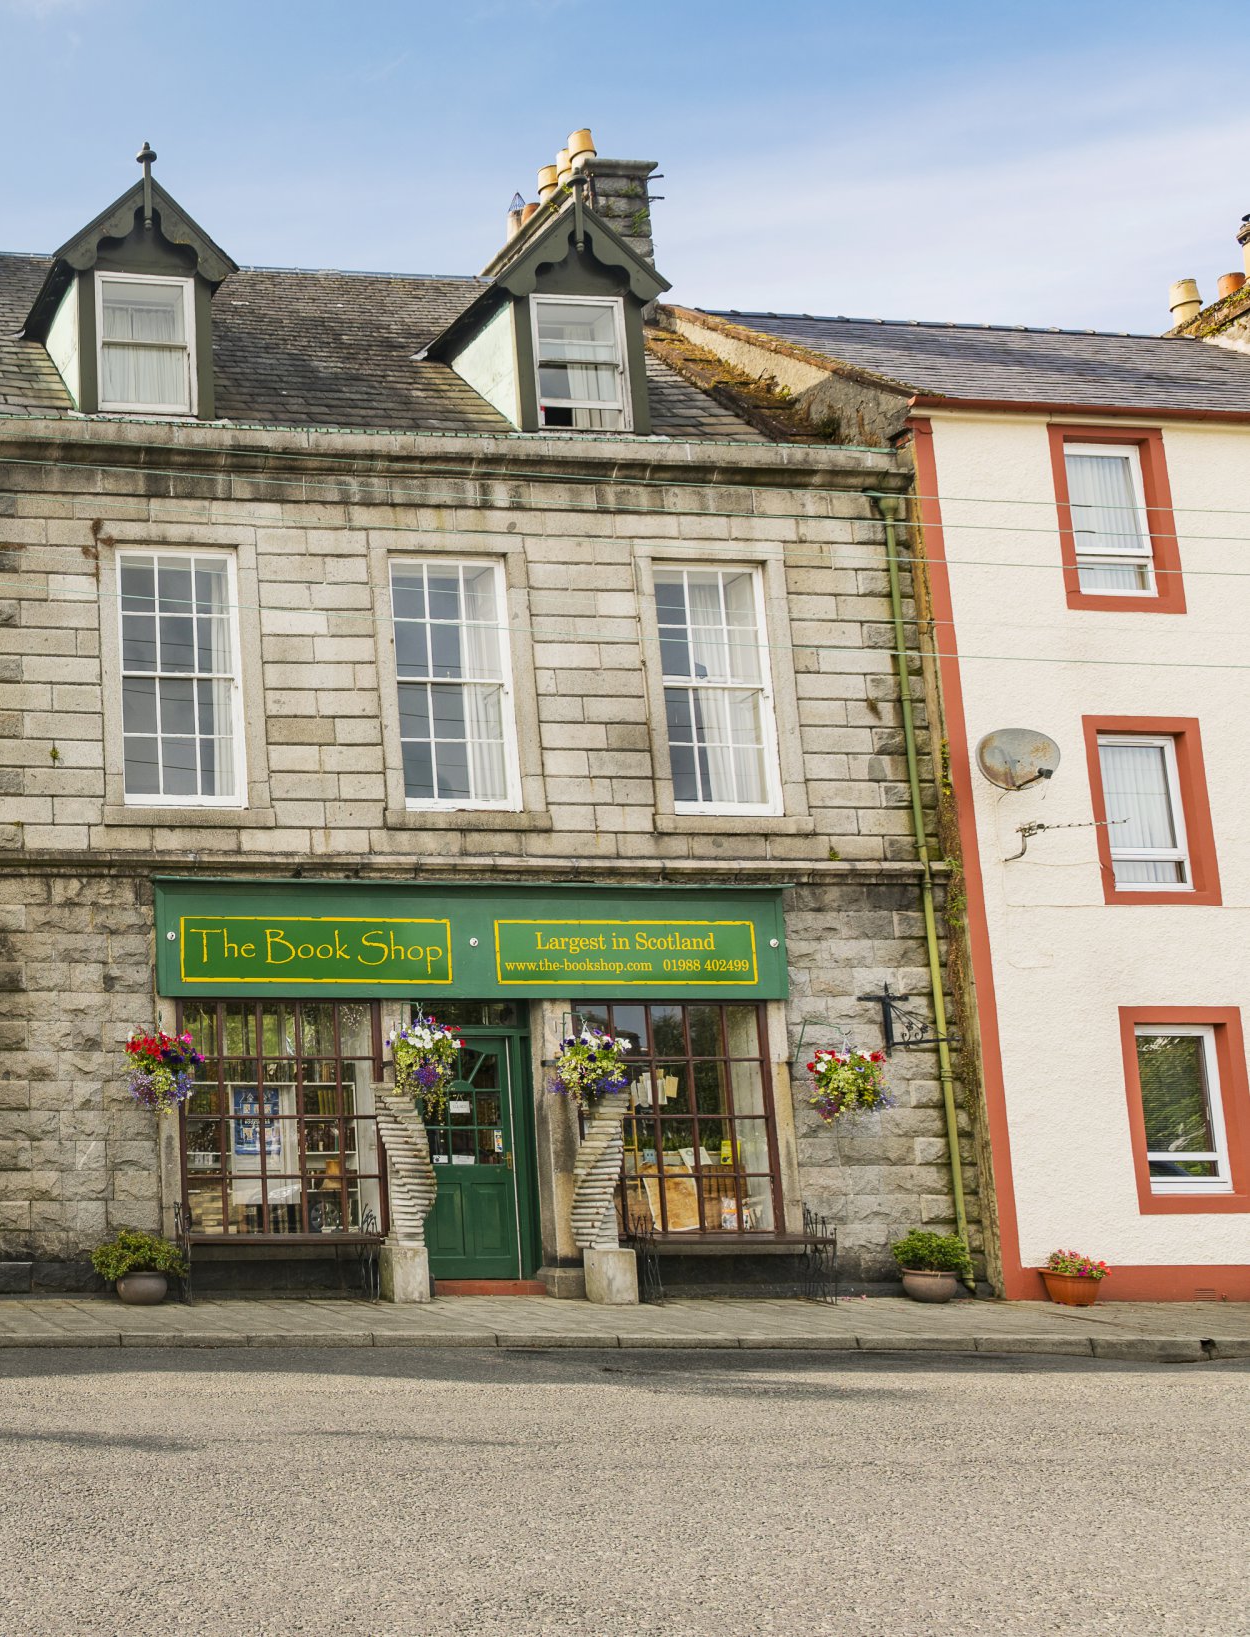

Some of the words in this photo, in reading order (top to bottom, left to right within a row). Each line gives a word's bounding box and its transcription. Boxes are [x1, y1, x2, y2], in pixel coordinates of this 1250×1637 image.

[189, 927, 257, 964] The
[264, 928, 351, 965] Book
[357, 930, 443, 975] Shop
[535, 931, 607, 954] Largest
[611, 931, 630, 951] in
[635, 932, 716, 951] Scotland
[504, 958, 653, 974] www.the-bookshop.com
[662, 958, 701, 972] 01988
[703, 959, 750, 972] 402499
